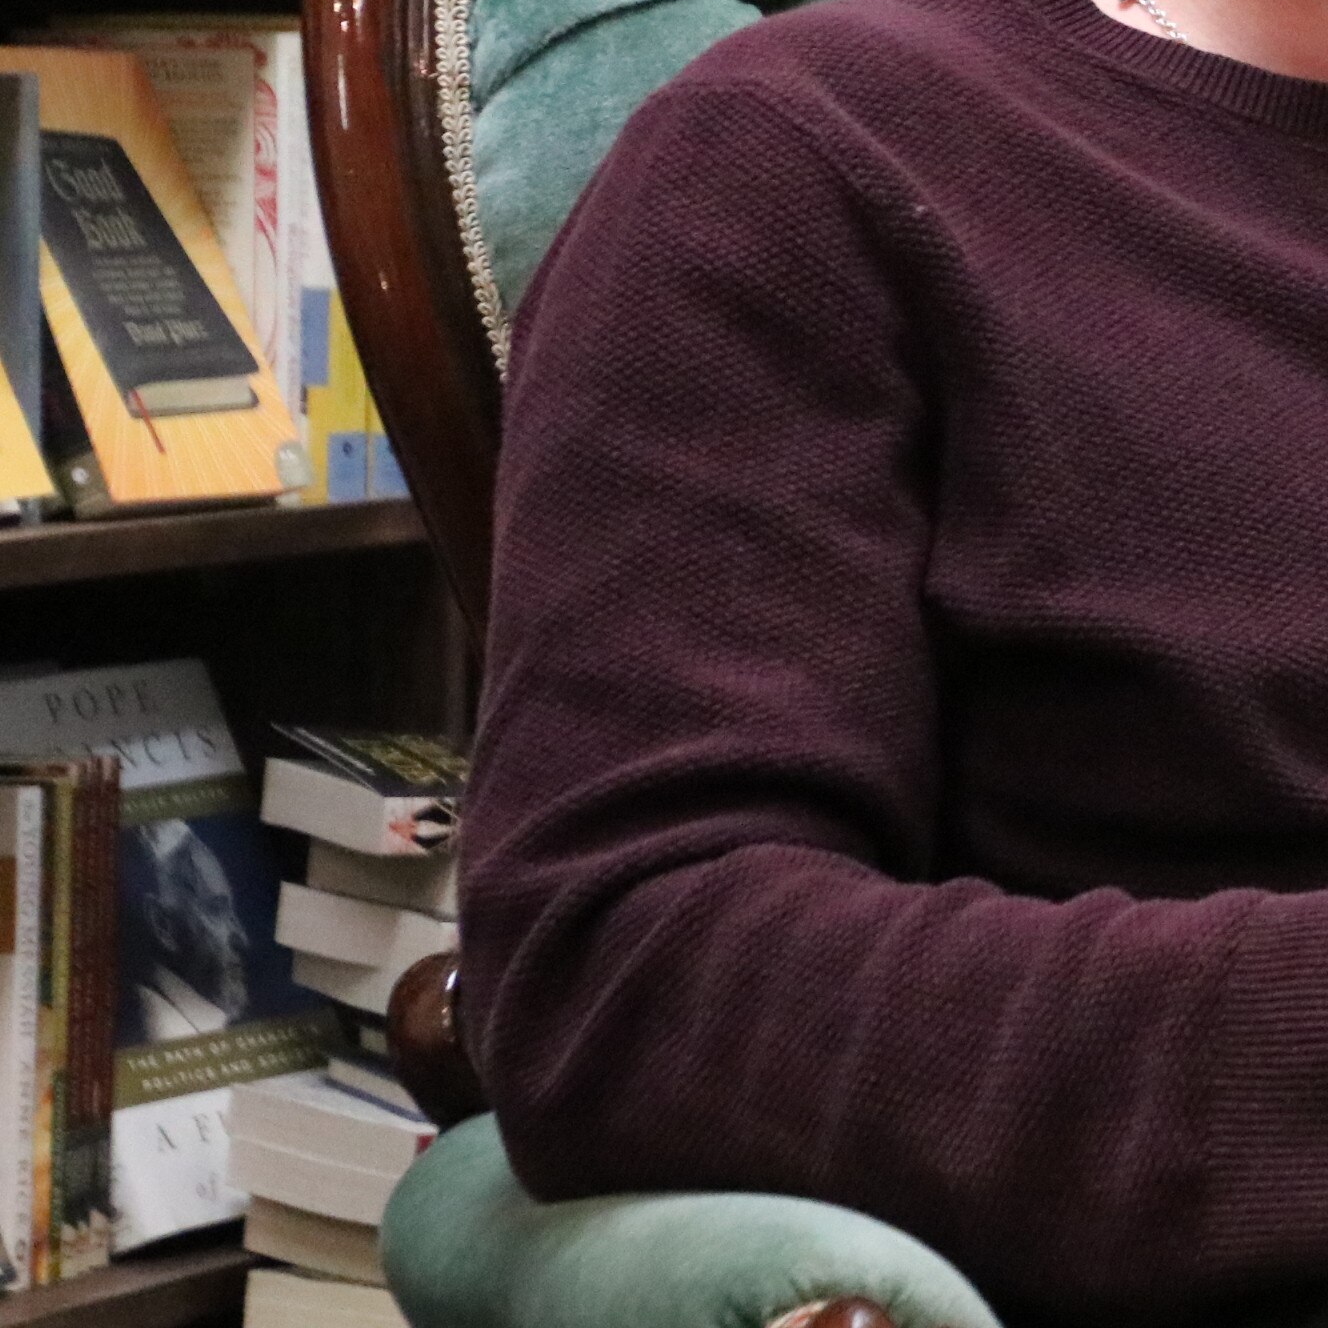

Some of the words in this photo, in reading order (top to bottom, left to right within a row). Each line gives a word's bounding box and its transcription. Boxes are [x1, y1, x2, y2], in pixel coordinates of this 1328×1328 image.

[45, 679, 158, 722] POPE
[128, 1054, 160, 1071] THE
[165, 1046, 204, 1064] PATH
[208, 1039, 231, 1056] OF
[220, 1057, 252, 1074] AND
